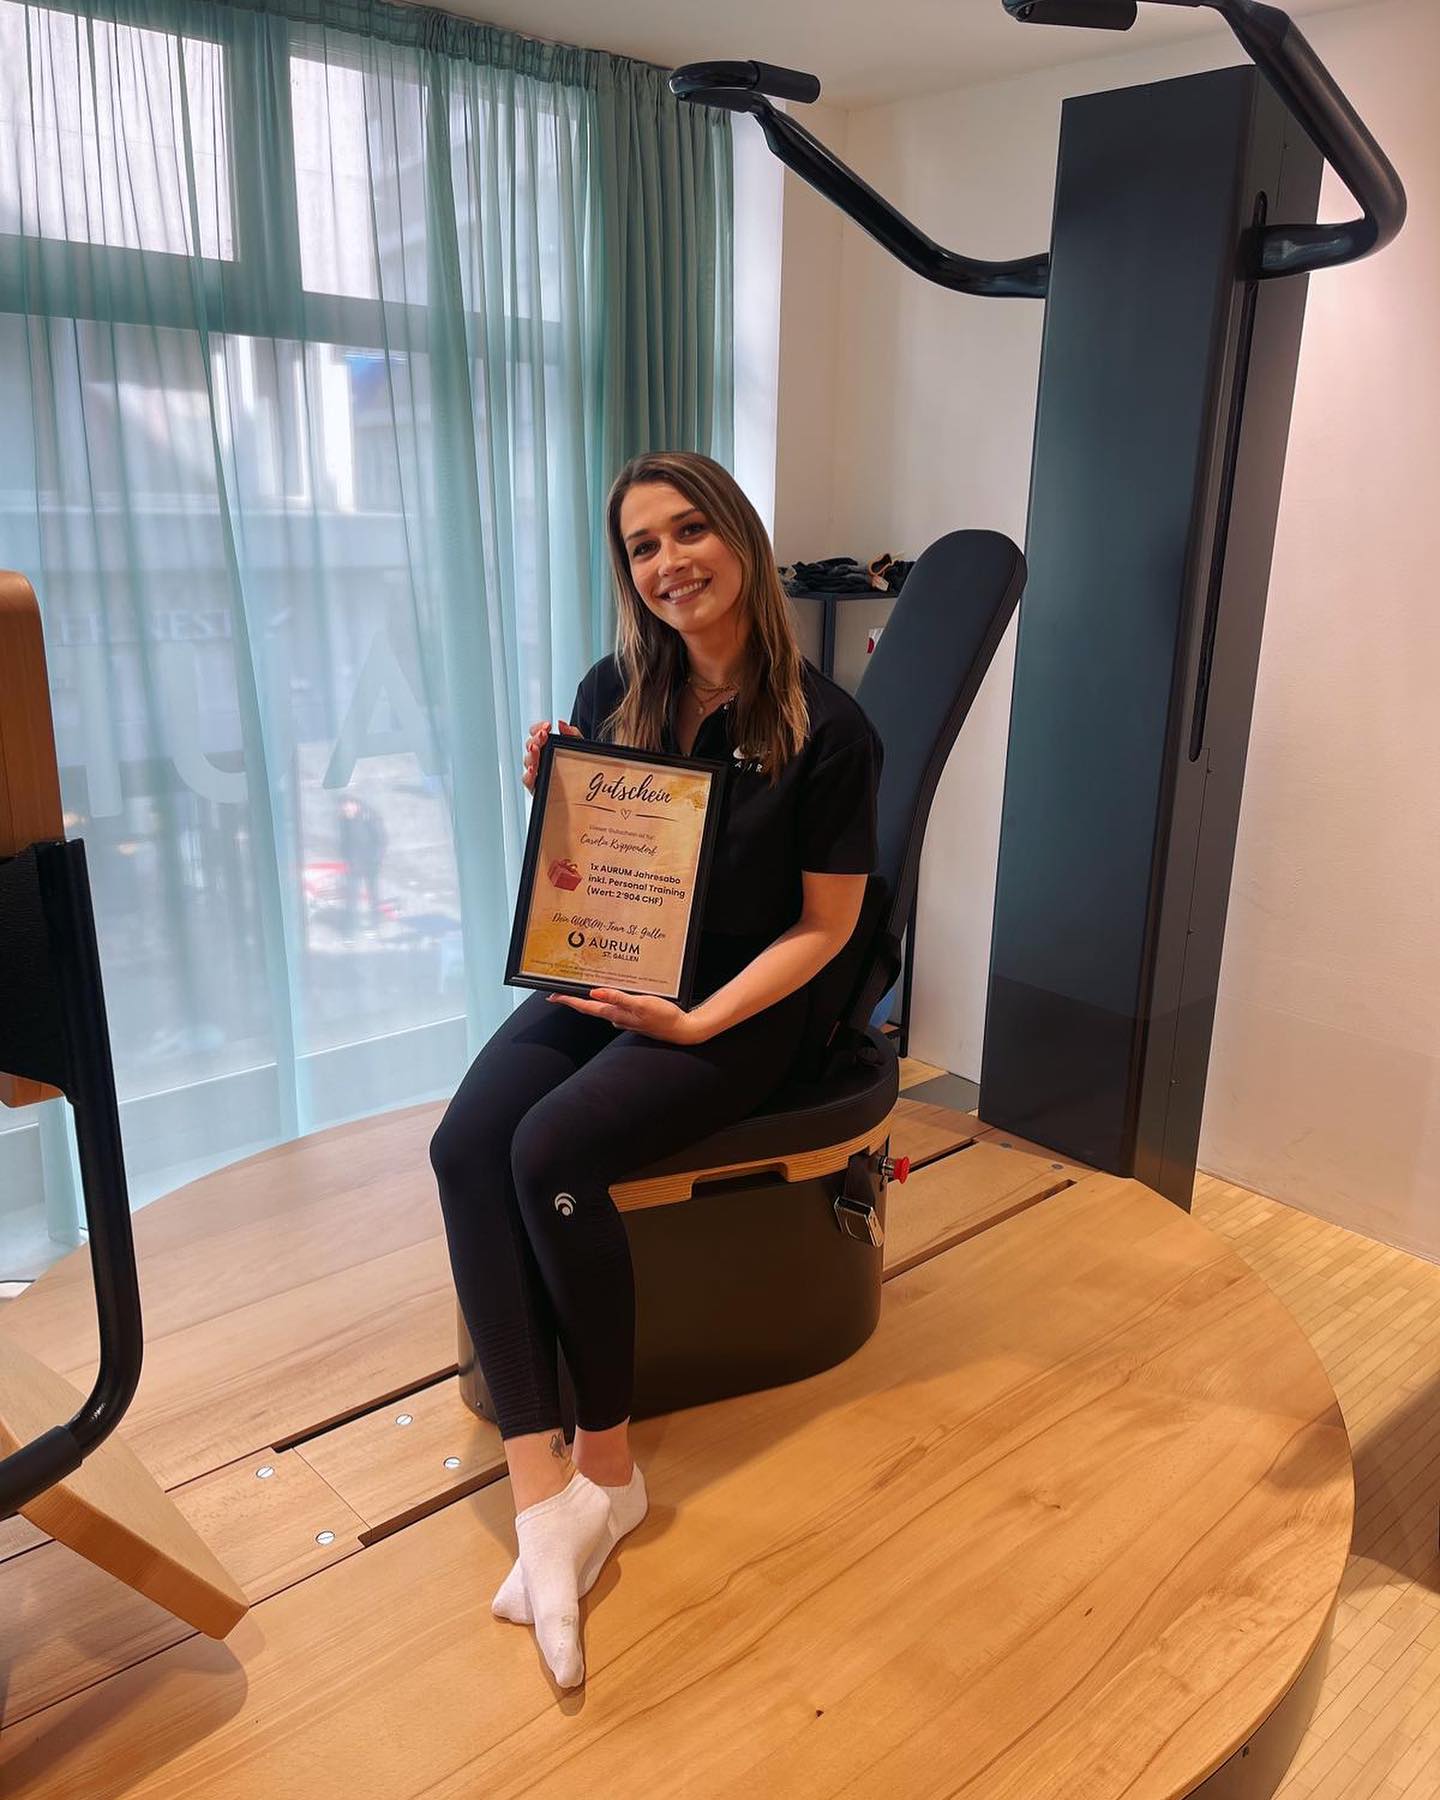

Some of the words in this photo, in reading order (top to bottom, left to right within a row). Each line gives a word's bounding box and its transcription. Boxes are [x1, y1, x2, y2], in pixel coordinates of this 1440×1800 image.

[585, 771, 673, 804] Gutschein
[590, 862, 600, 872] 1x
[600, 865, 633, 877] AURUM
[633, 871, 681, 885] Jahresabo
[586, 885, 615, 898] (Wert:
[641, 895, 664, 907] CHF)
[588, 874, 607, 885] inkl.
[608, 877, 648, 891] Personal
[649, 884, 686, 900] Training
[588, 937, 640, 955] AURUM
[613, 952, 639, 962] GALLEN
